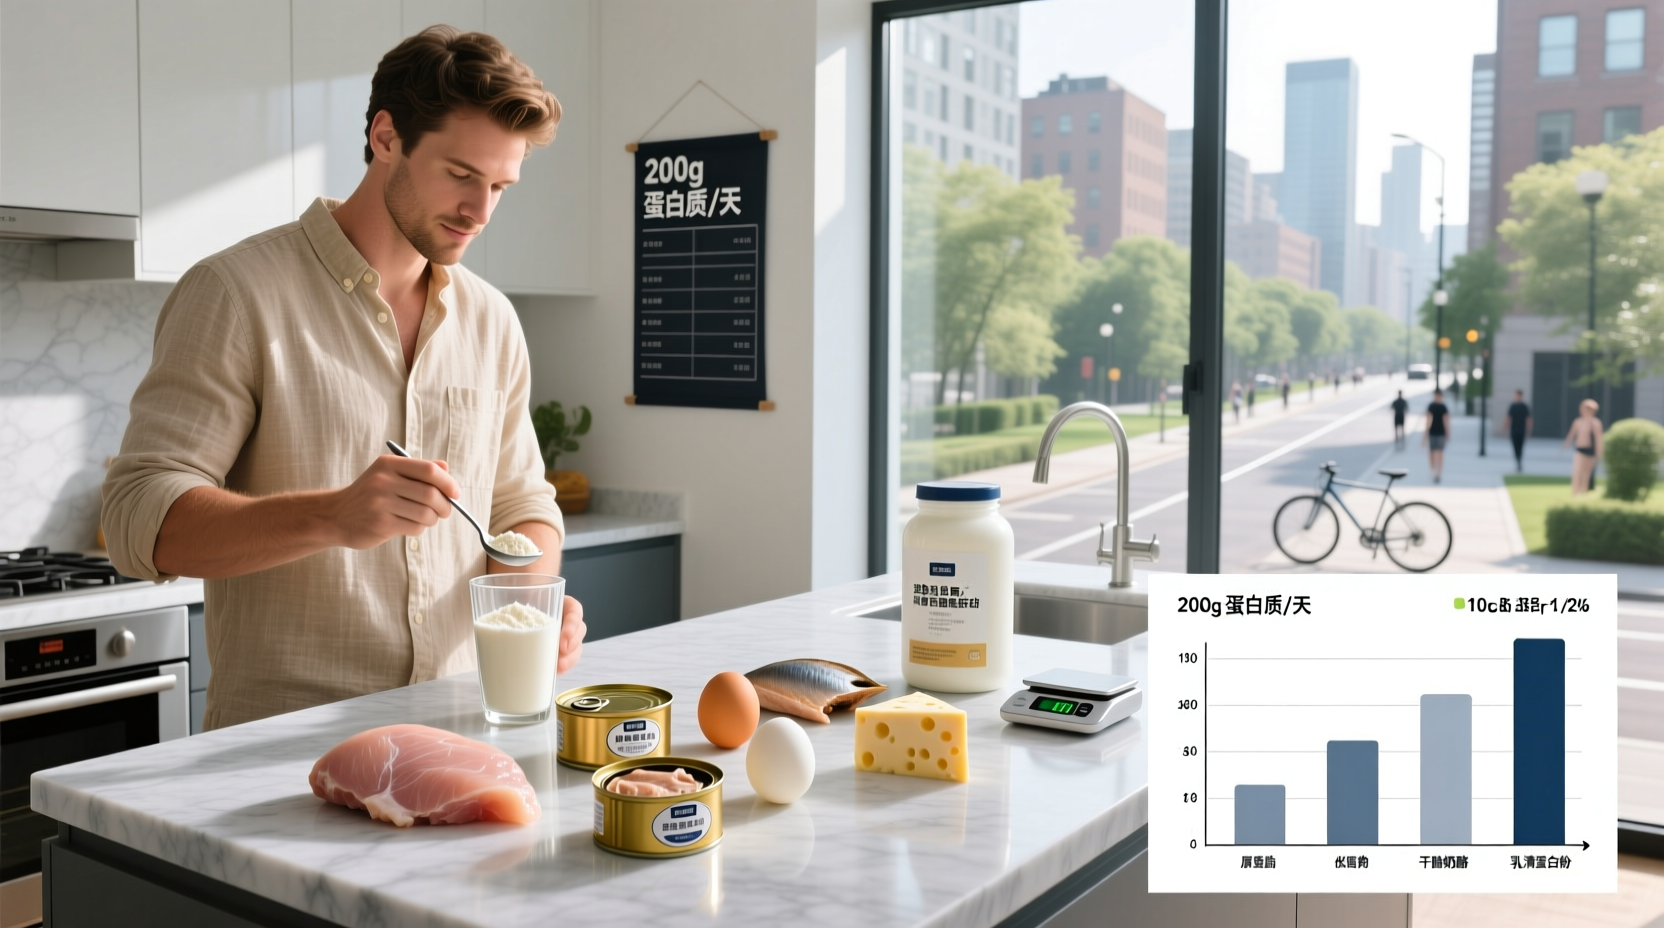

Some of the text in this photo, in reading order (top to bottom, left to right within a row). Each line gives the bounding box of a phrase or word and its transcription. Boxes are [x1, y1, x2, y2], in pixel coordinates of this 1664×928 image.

[644, 155, 704, 187] 200g
[643, 187, 742, 219] 蛋白质/天
